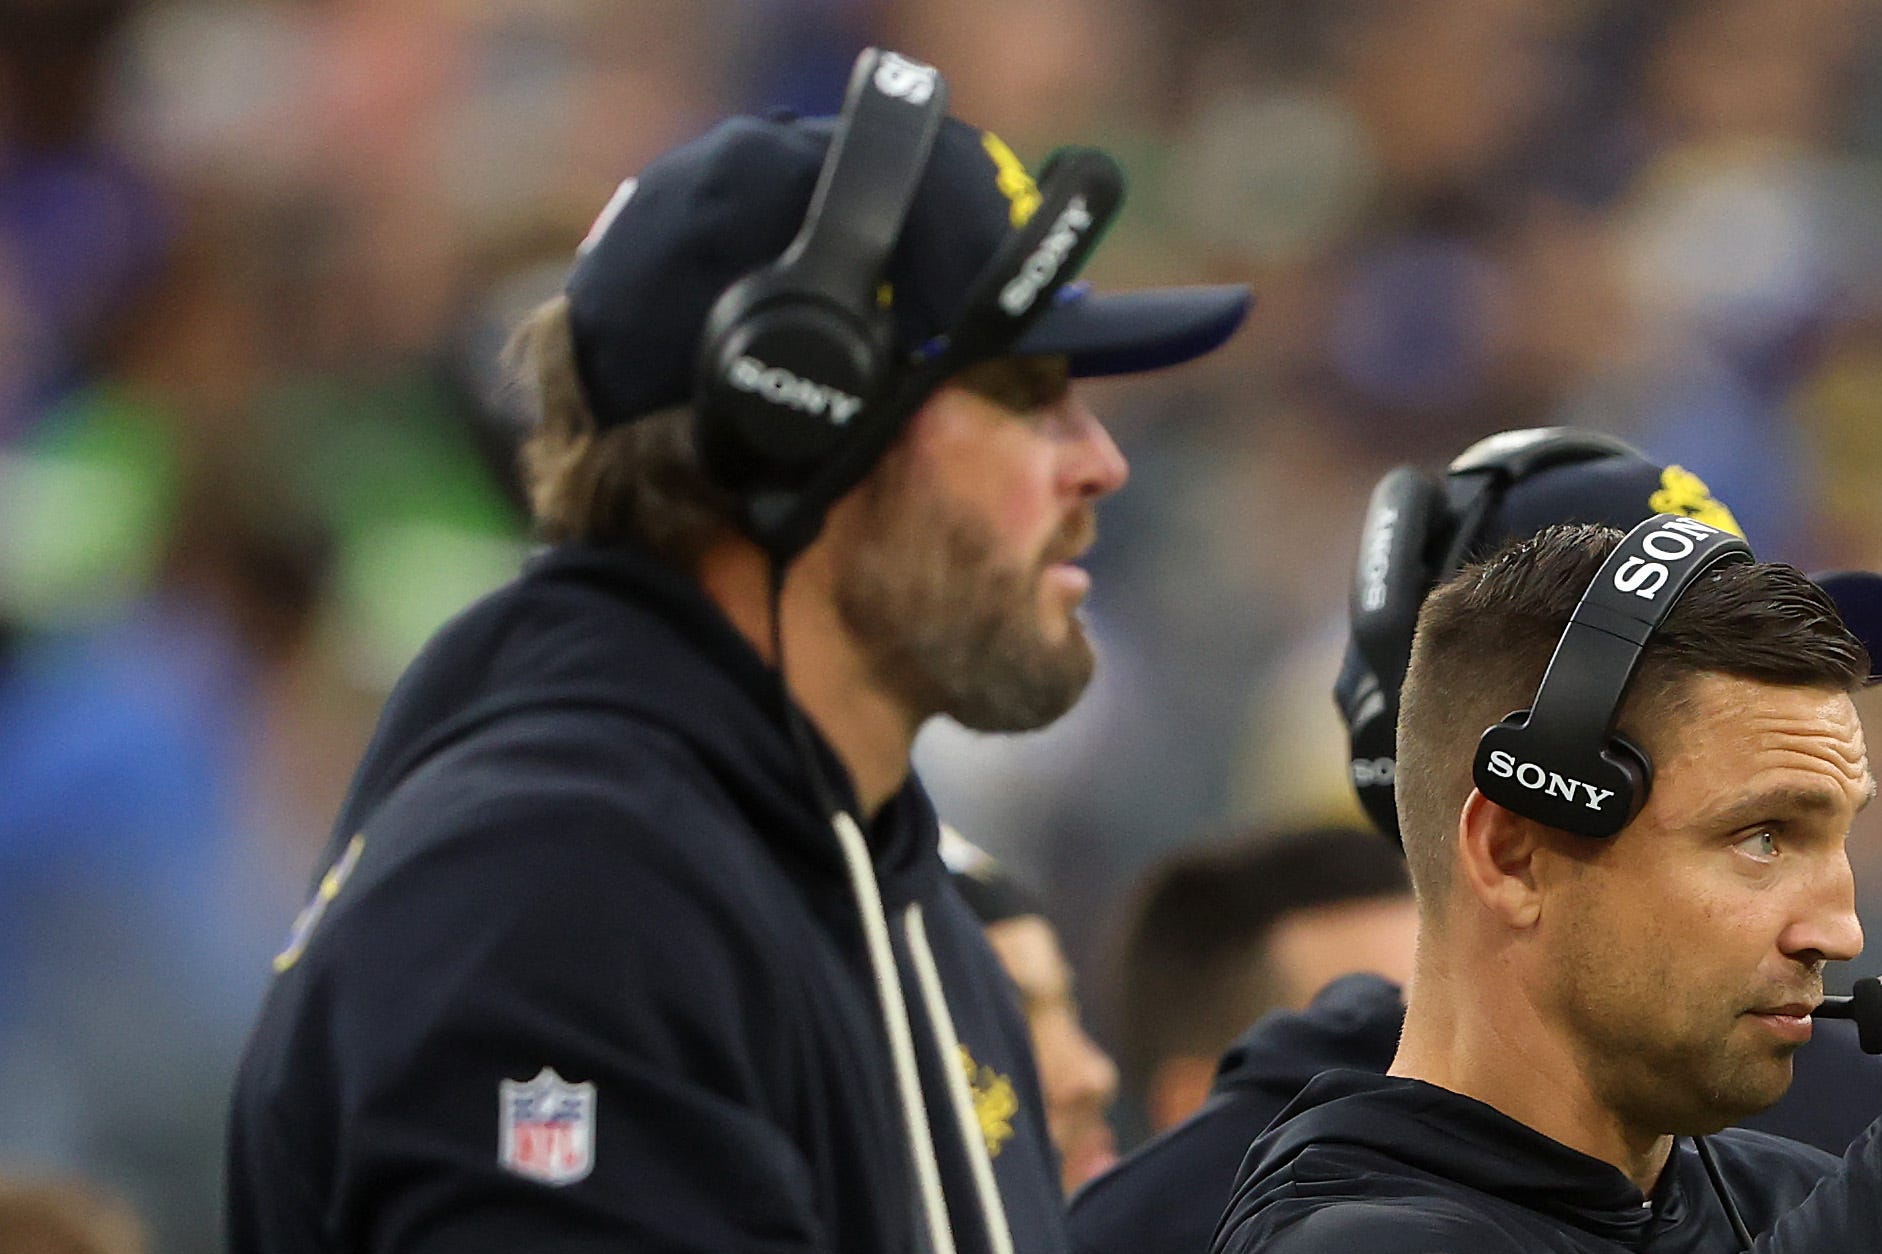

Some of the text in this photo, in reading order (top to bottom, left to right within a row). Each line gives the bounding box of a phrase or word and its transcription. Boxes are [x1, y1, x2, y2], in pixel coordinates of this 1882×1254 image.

[874, 51, 937, 105] SO
[1000, 196, 1092, 315] SONY
[729, 356, 862, 425] SONY
[1614, 517, 1720, 600] SON
[1352, 757, 1395, 787] SO
[1487, 751, 1615, 811] SONY
